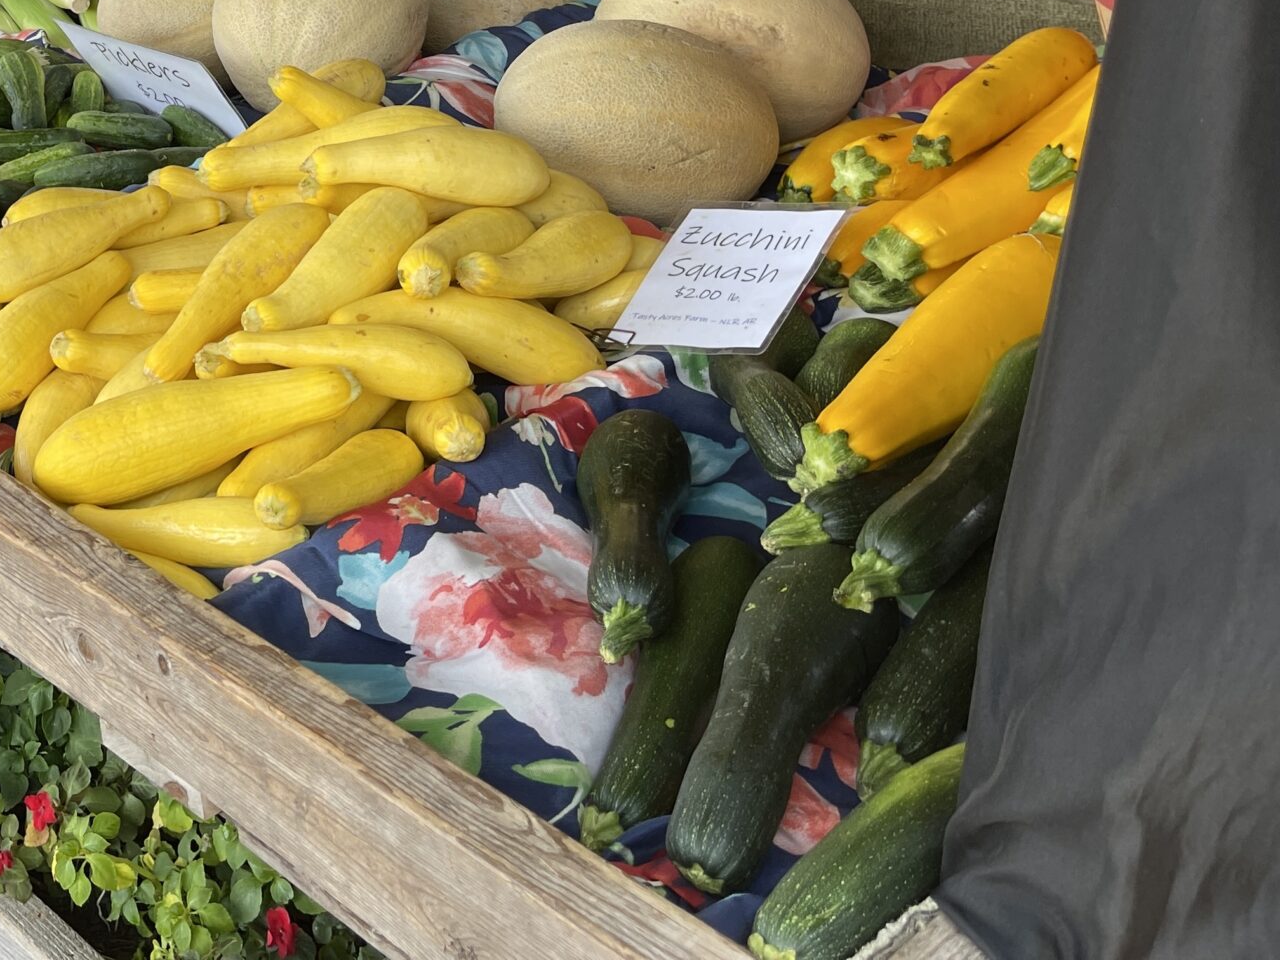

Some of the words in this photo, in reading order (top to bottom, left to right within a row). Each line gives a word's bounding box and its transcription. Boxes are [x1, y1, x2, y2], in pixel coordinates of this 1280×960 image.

[89, 41, 191, 88] Picklers
[680, 225, 814, 251] Zucchini
[668, 257, 779, 284] Squash
[675, 285, 722, 301] $2.00
